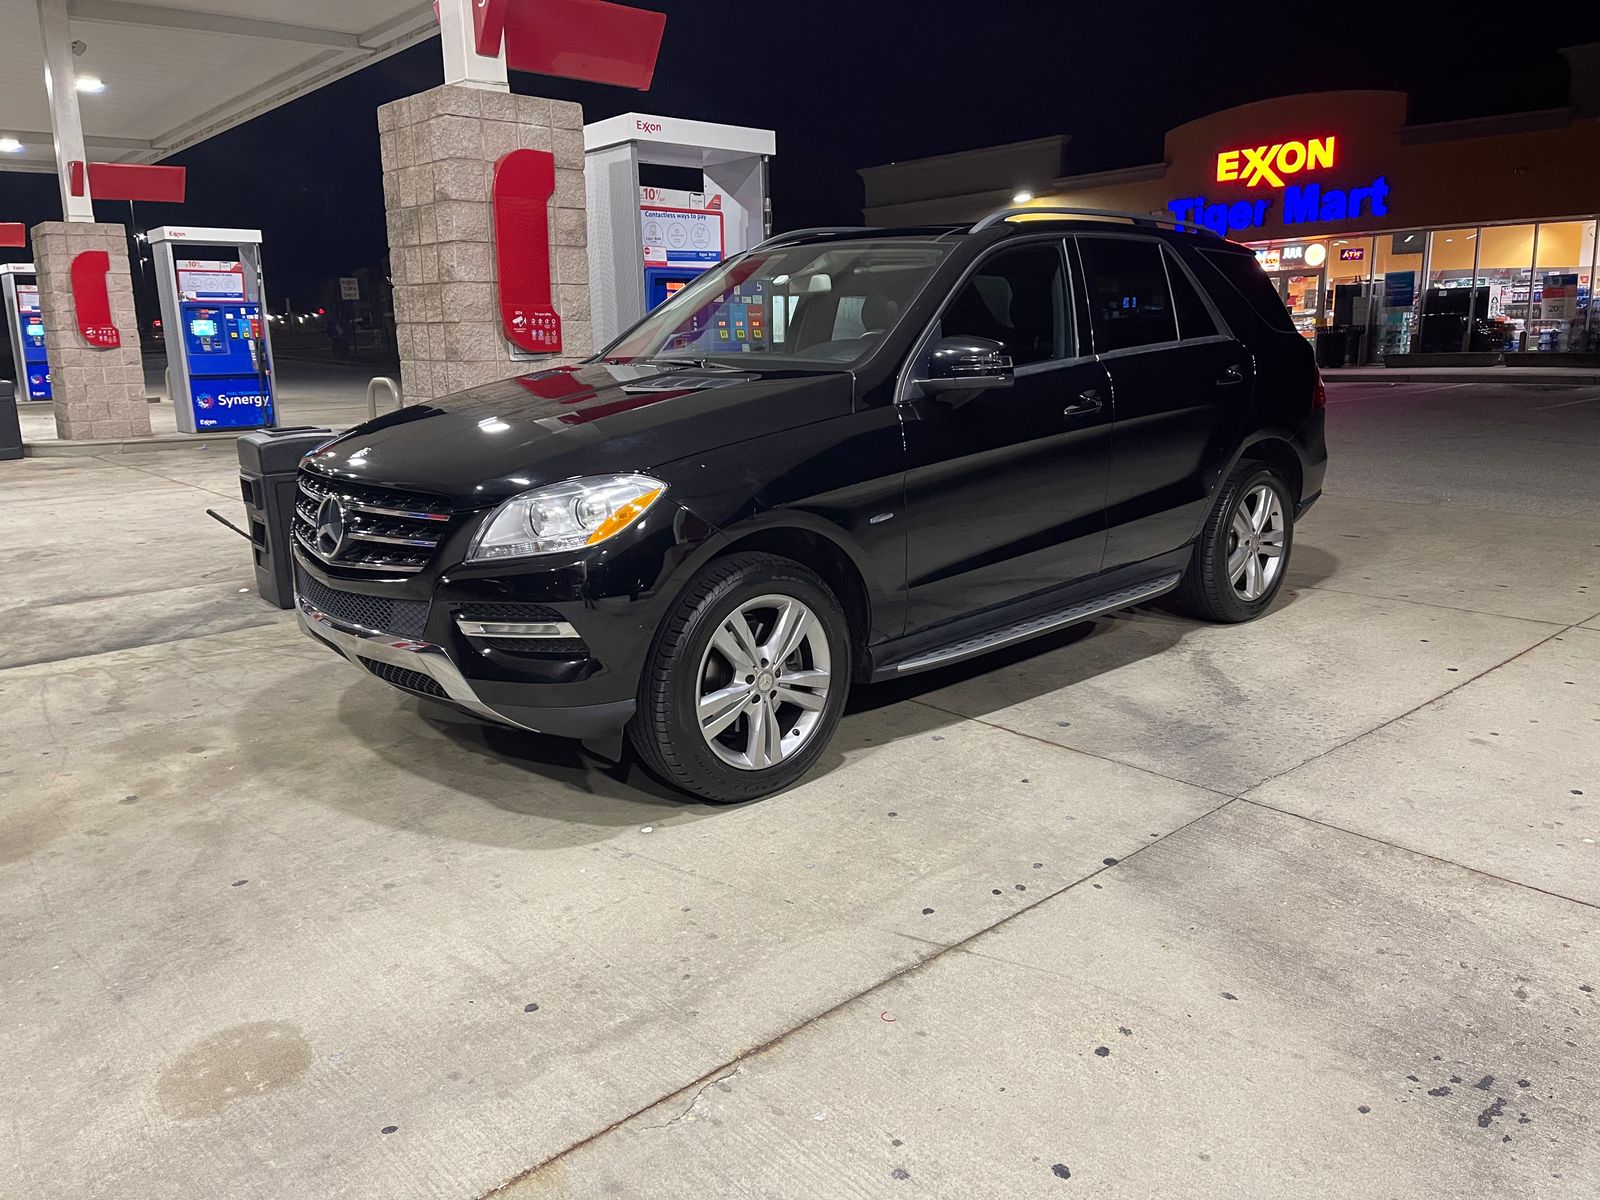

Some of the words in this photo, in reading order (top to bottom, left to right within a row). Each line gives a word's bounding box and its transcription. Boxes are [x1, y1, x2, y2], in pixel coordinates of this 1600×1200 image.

[636, 120, 662, 134] Exxon
[1216, 136, 1336, 187] EXXON
[1167, 196, 1272, 237] Tiger
[1283, 175, 1389, 225] Mart
[644, 211, 676, 219] Contactless
[677, 212, 690, 220] ways
[756, 281, 763, 292] 5
[217, 394, 269, 409] Synergy
